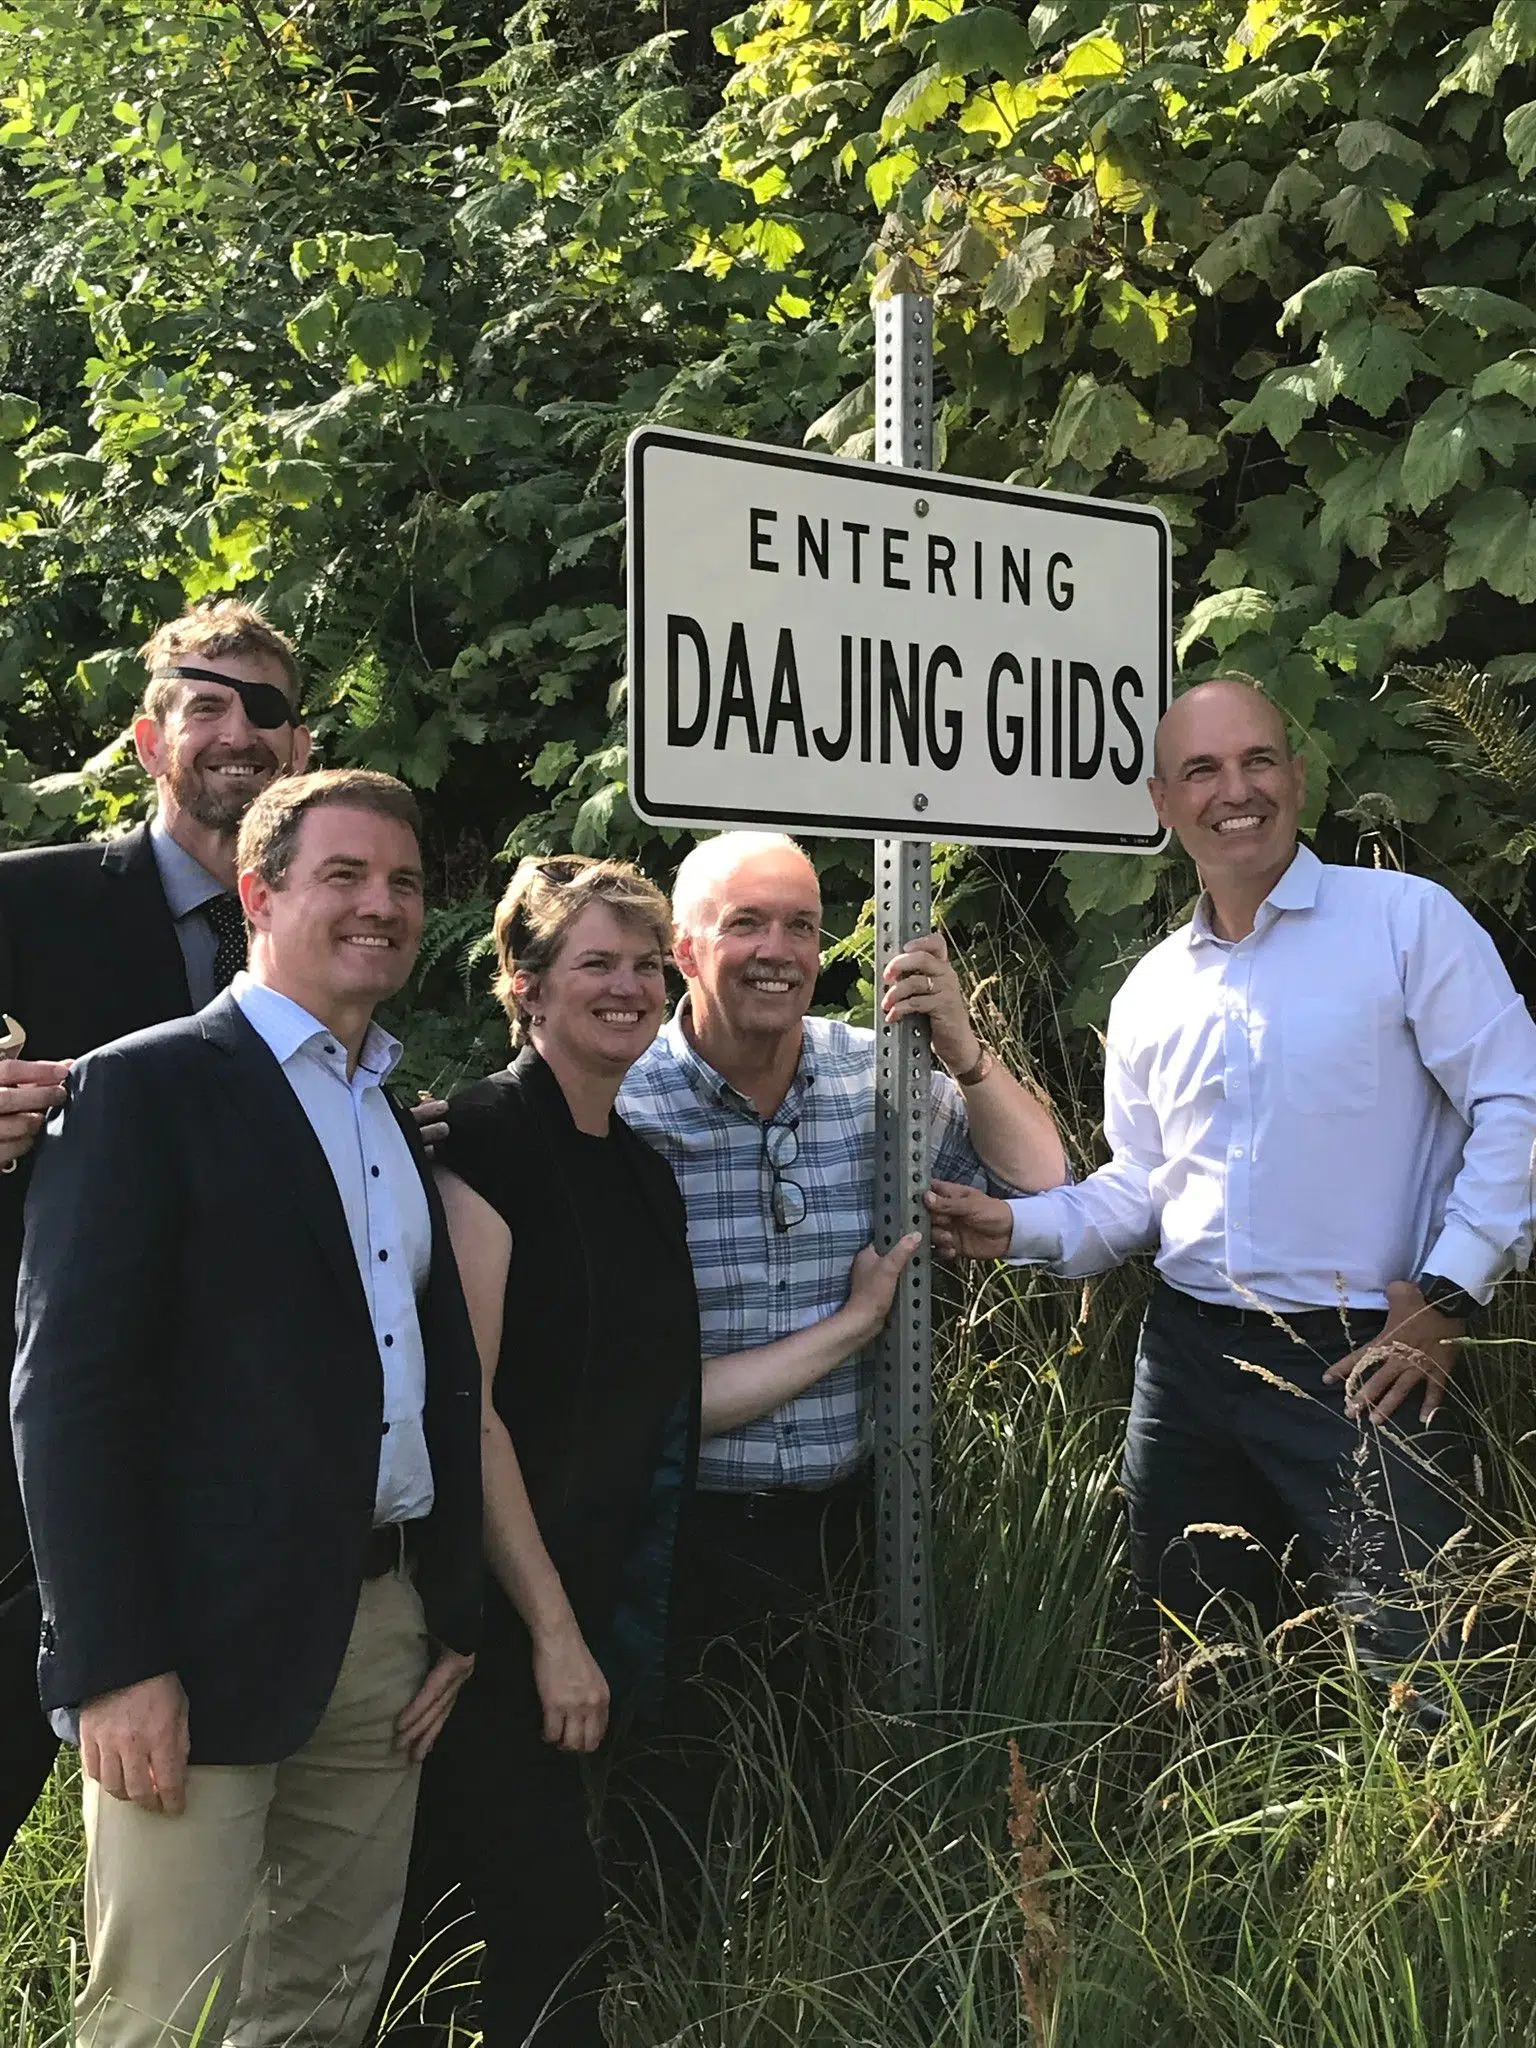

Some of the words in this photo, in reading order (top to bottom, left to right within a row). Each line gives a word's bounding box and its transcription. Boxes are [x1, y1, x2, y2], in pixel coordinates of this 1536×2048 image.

[749, 507, 1075, 612] ENTERING
[666, 613, 963, 772] DAAJING
[986, 651, 1144, 786] GIIDS
